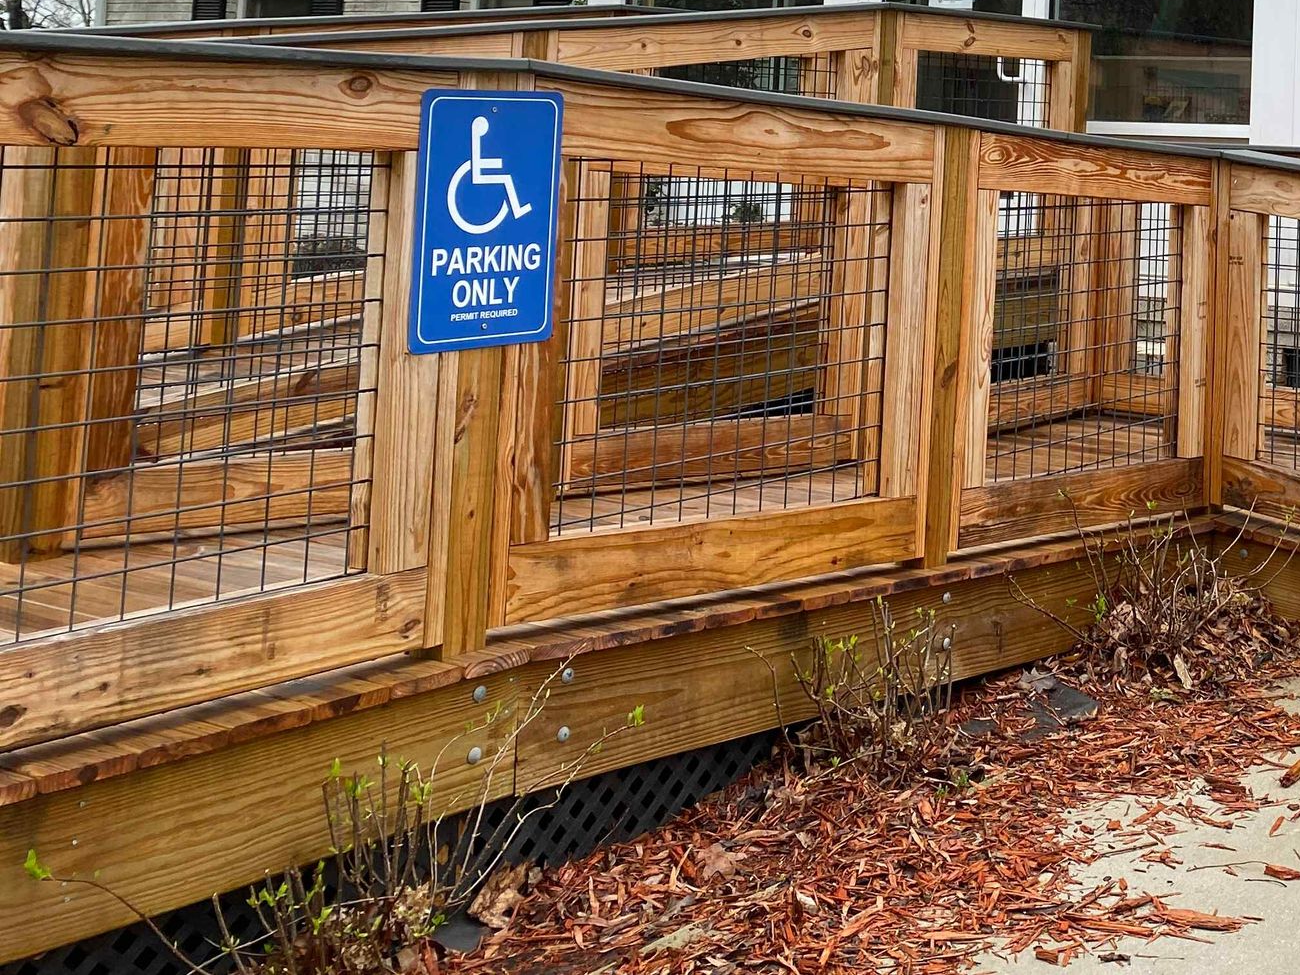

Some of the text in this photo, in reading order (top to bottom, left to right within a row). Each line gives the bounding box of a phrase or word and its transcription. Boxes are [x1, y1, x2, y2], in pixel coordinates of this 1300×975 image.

[431, 243, 541, 277] PARKING
[451, 276, 520, 308] ONLY
[450, 308, 518, 322] PERMIT REQUIRED
